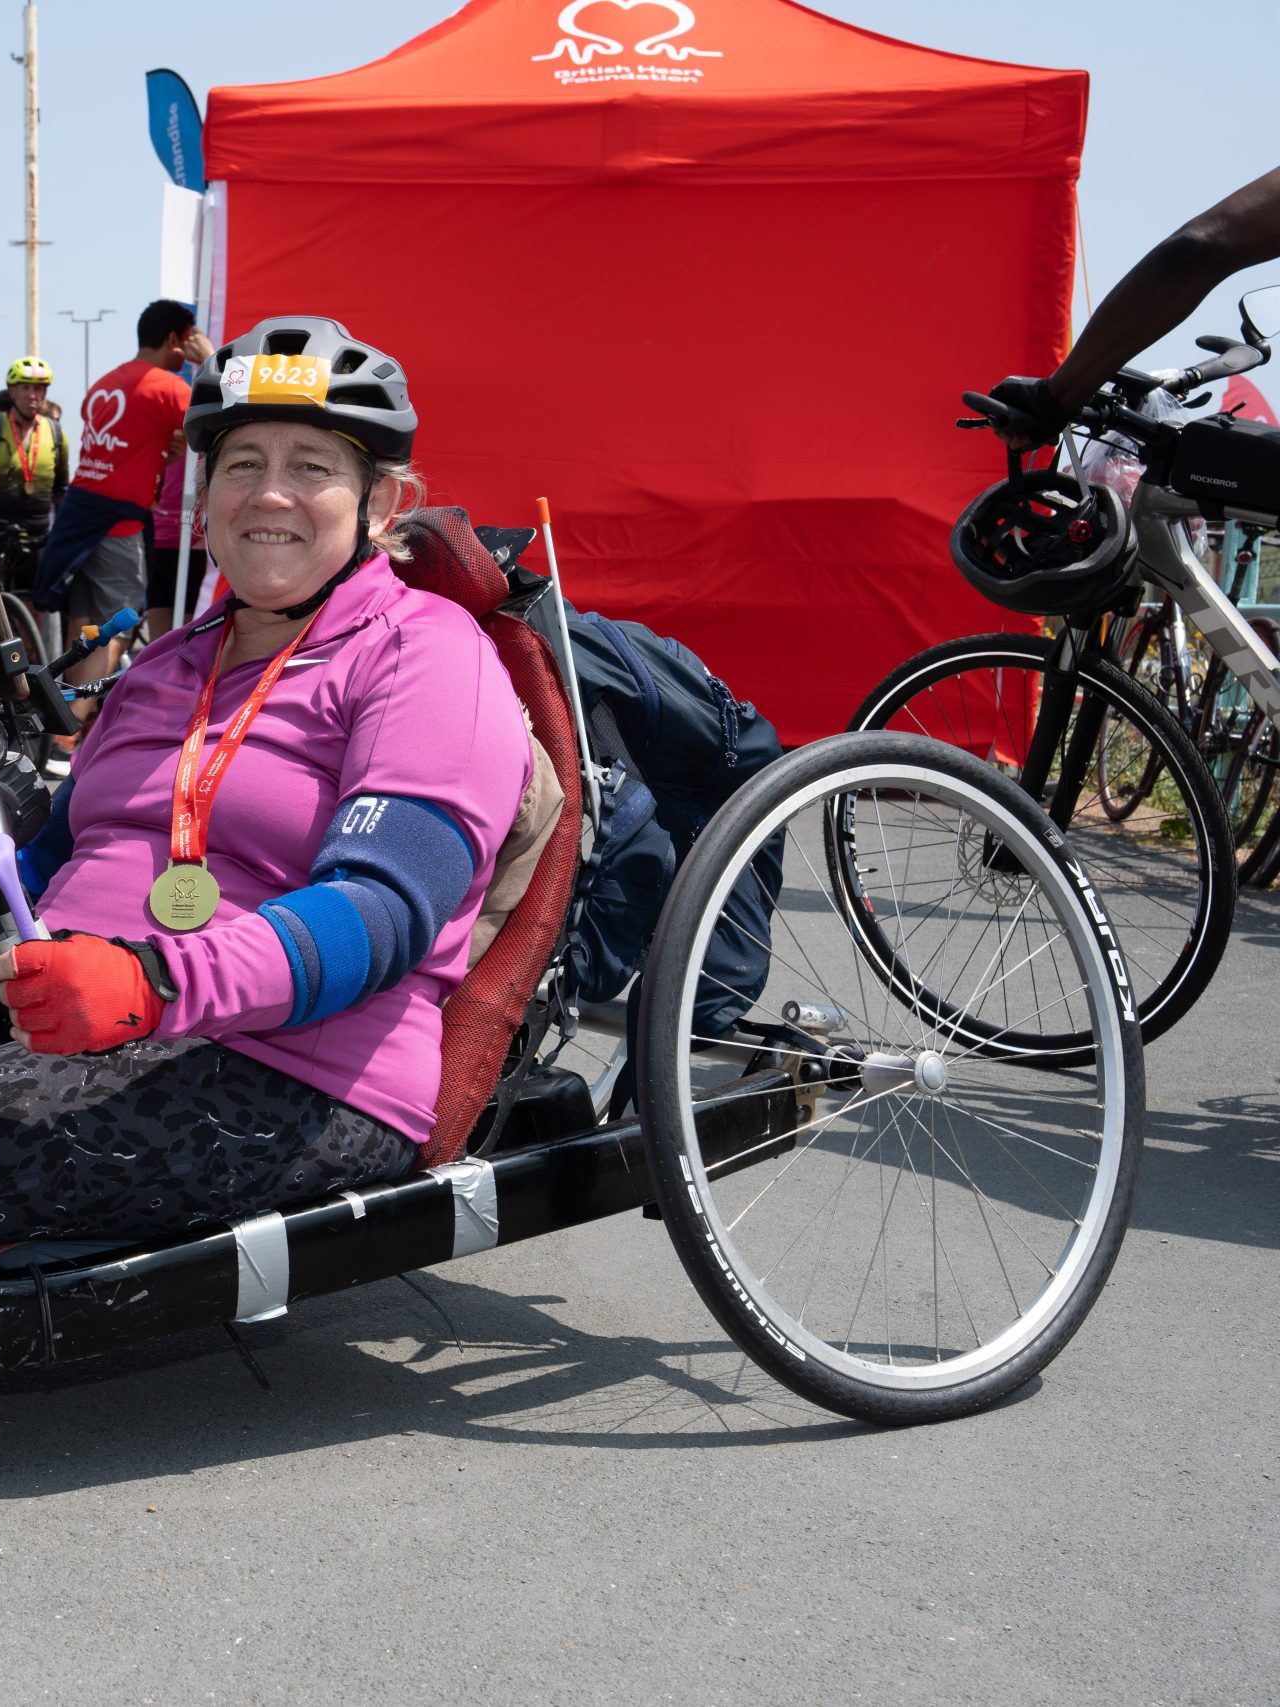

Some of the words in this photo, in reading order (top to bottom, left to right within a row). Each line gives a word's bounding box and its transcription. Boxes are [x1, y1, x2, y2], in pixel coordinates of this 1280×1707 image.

[554, 64, 631, 79] British
[637, 65, 704, 77] Heart
[561, 73, 699, 85] Foundation
[258, 366, 318, 387] 9623
[1190, 473, 1238, 489] ROCKBROS
[366, 799, 390, 834] NEO
[1065, 857, 1136, 1022] KOJAK
[678, 1155, 807, 1362] SCHWALBE
